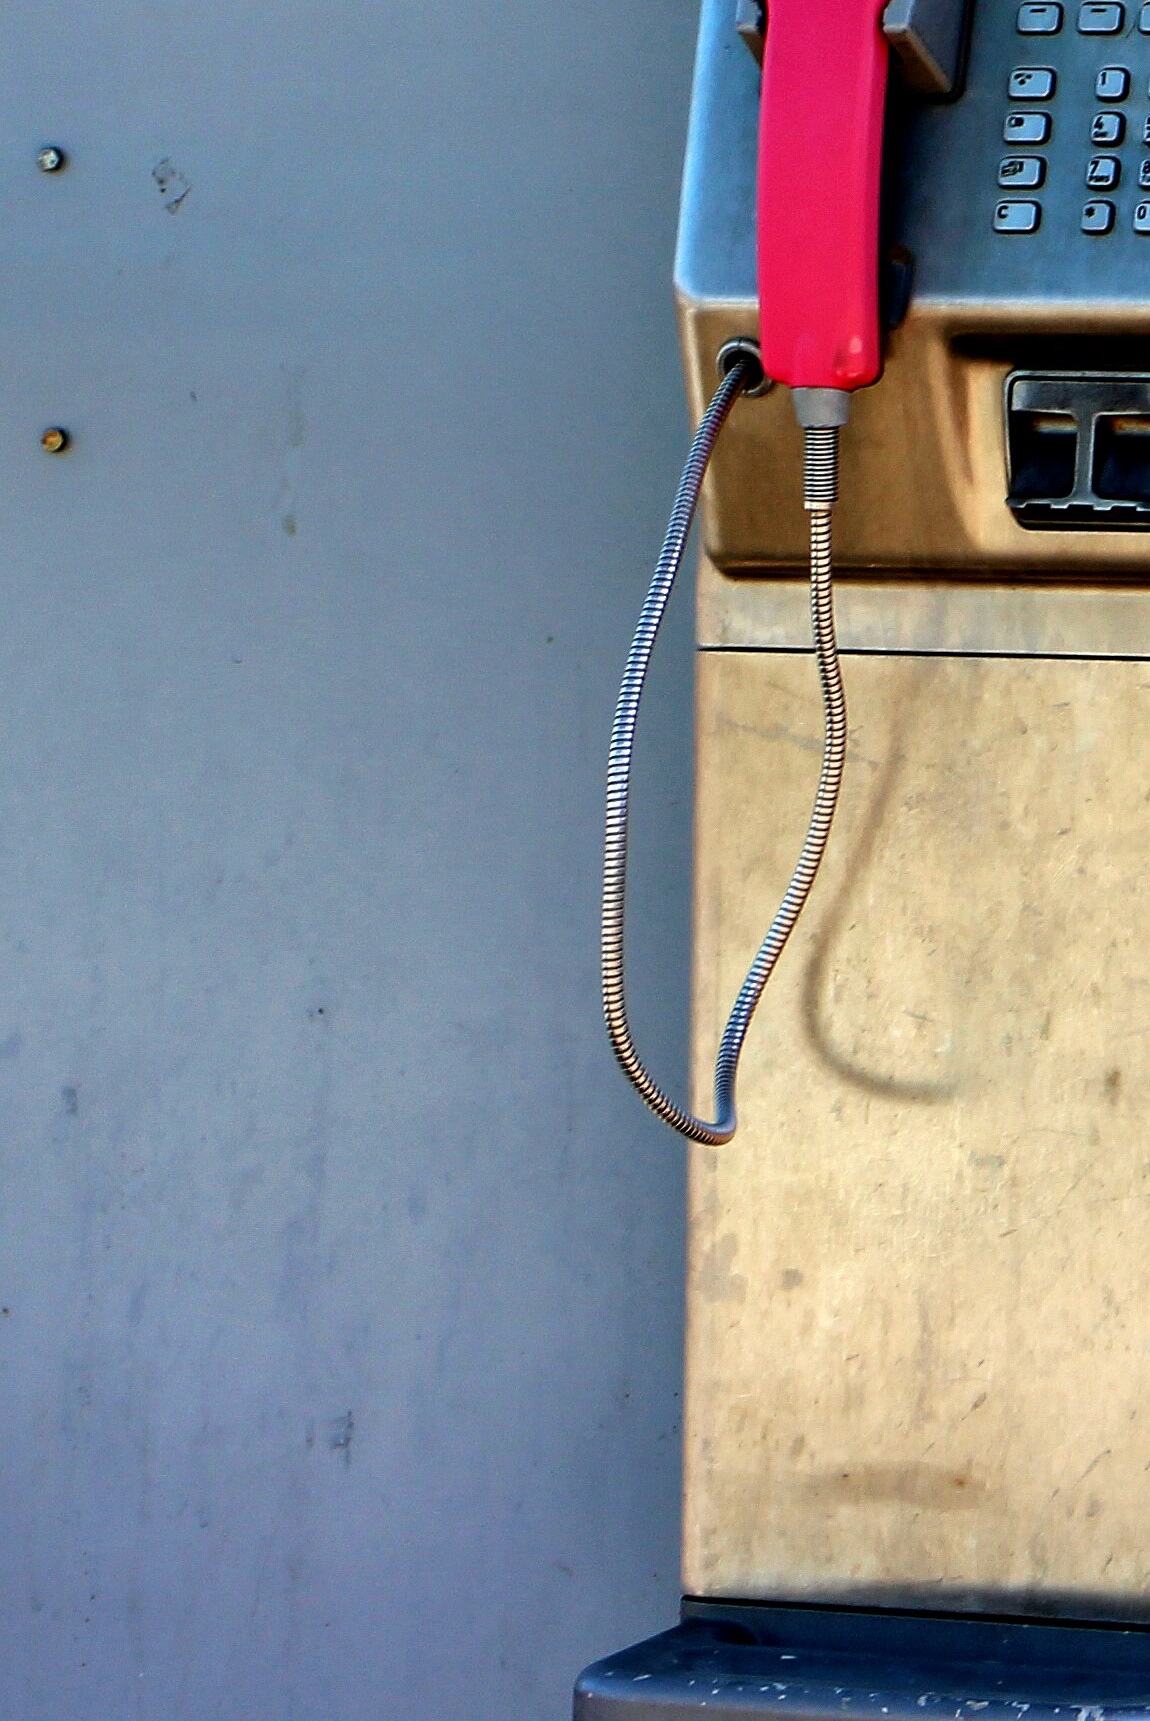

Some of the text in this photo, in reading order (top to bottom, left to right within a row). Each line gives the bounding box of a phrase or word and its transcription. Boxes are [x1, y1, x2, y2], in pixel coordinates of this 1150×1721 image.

[1099, 71, 1108, 86] 1
[1093, 116, 1104, 130] 4
[1089, 160, 1100, 175] 7
[997, 205, 1009, 219] C
[1136, 205, 1147, 220] 0
